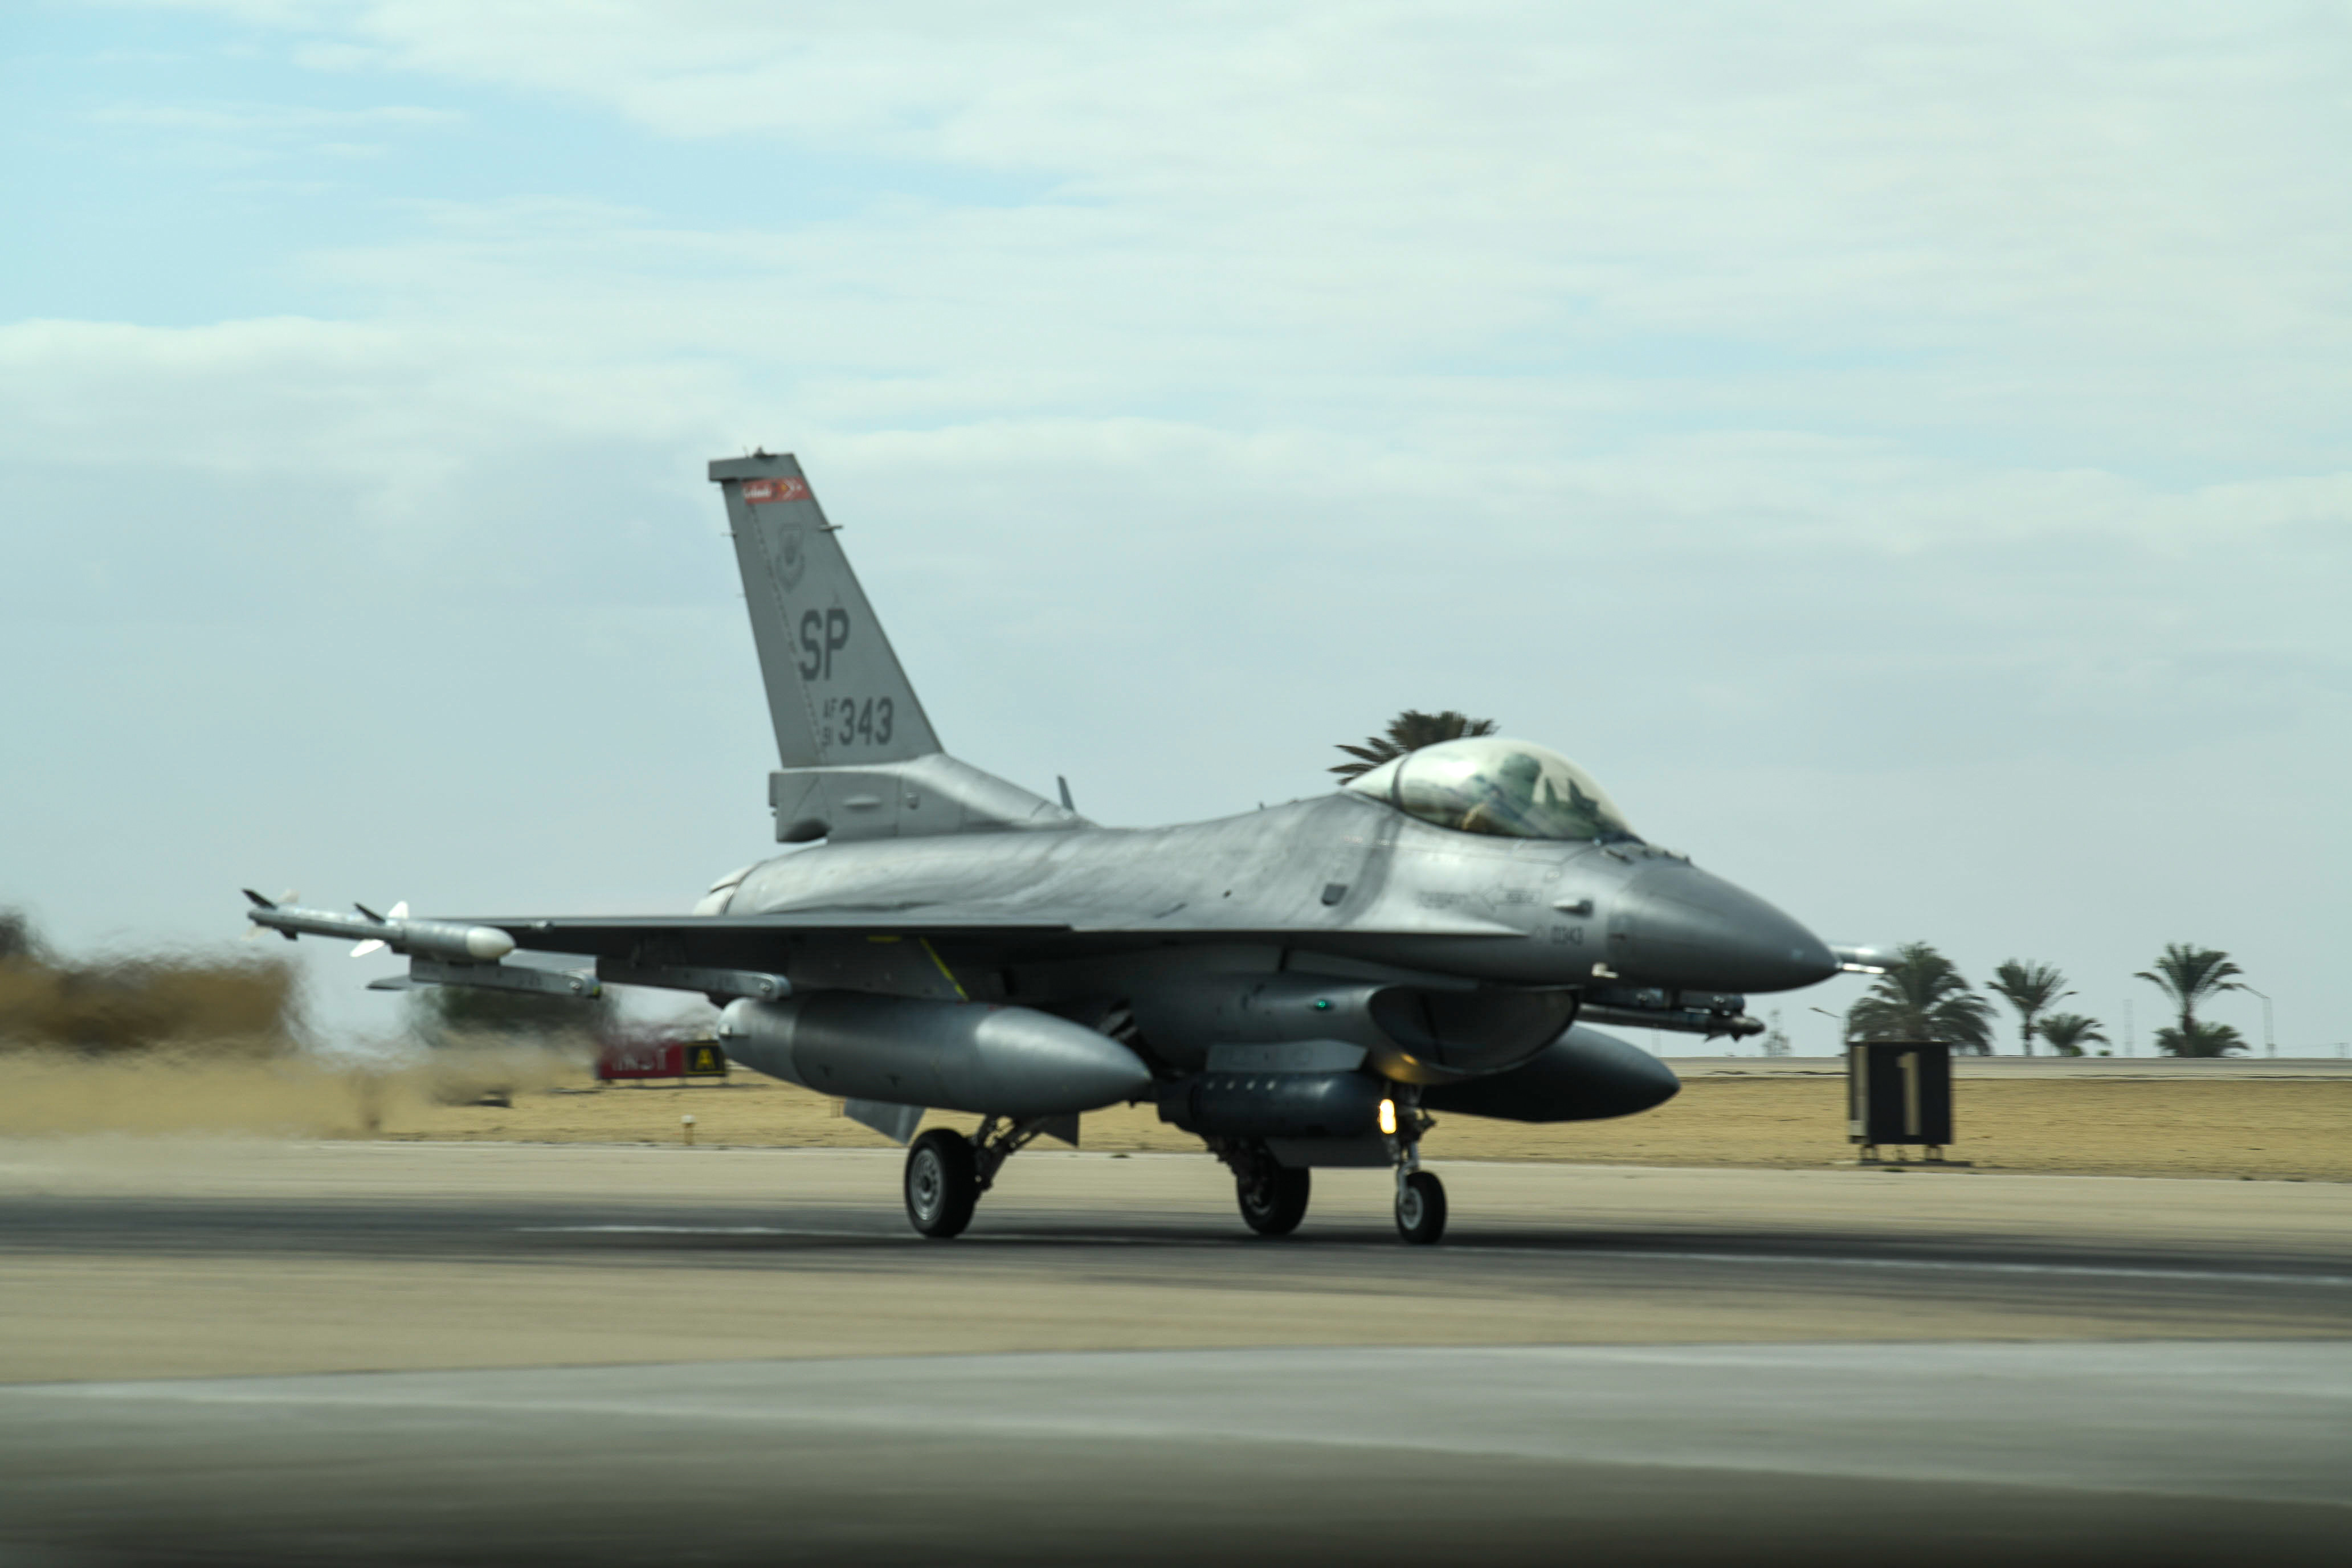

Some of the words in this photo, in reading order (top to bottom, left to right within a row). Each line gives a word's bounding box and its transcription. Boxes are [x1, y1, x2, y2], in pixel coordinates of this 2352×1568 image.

[798, 608, 850, 681] SP
[839, 696, 894, 746] 343
[695, 1047, 717, 1070] A
[1896, 1052, 1921, 1136] 1
